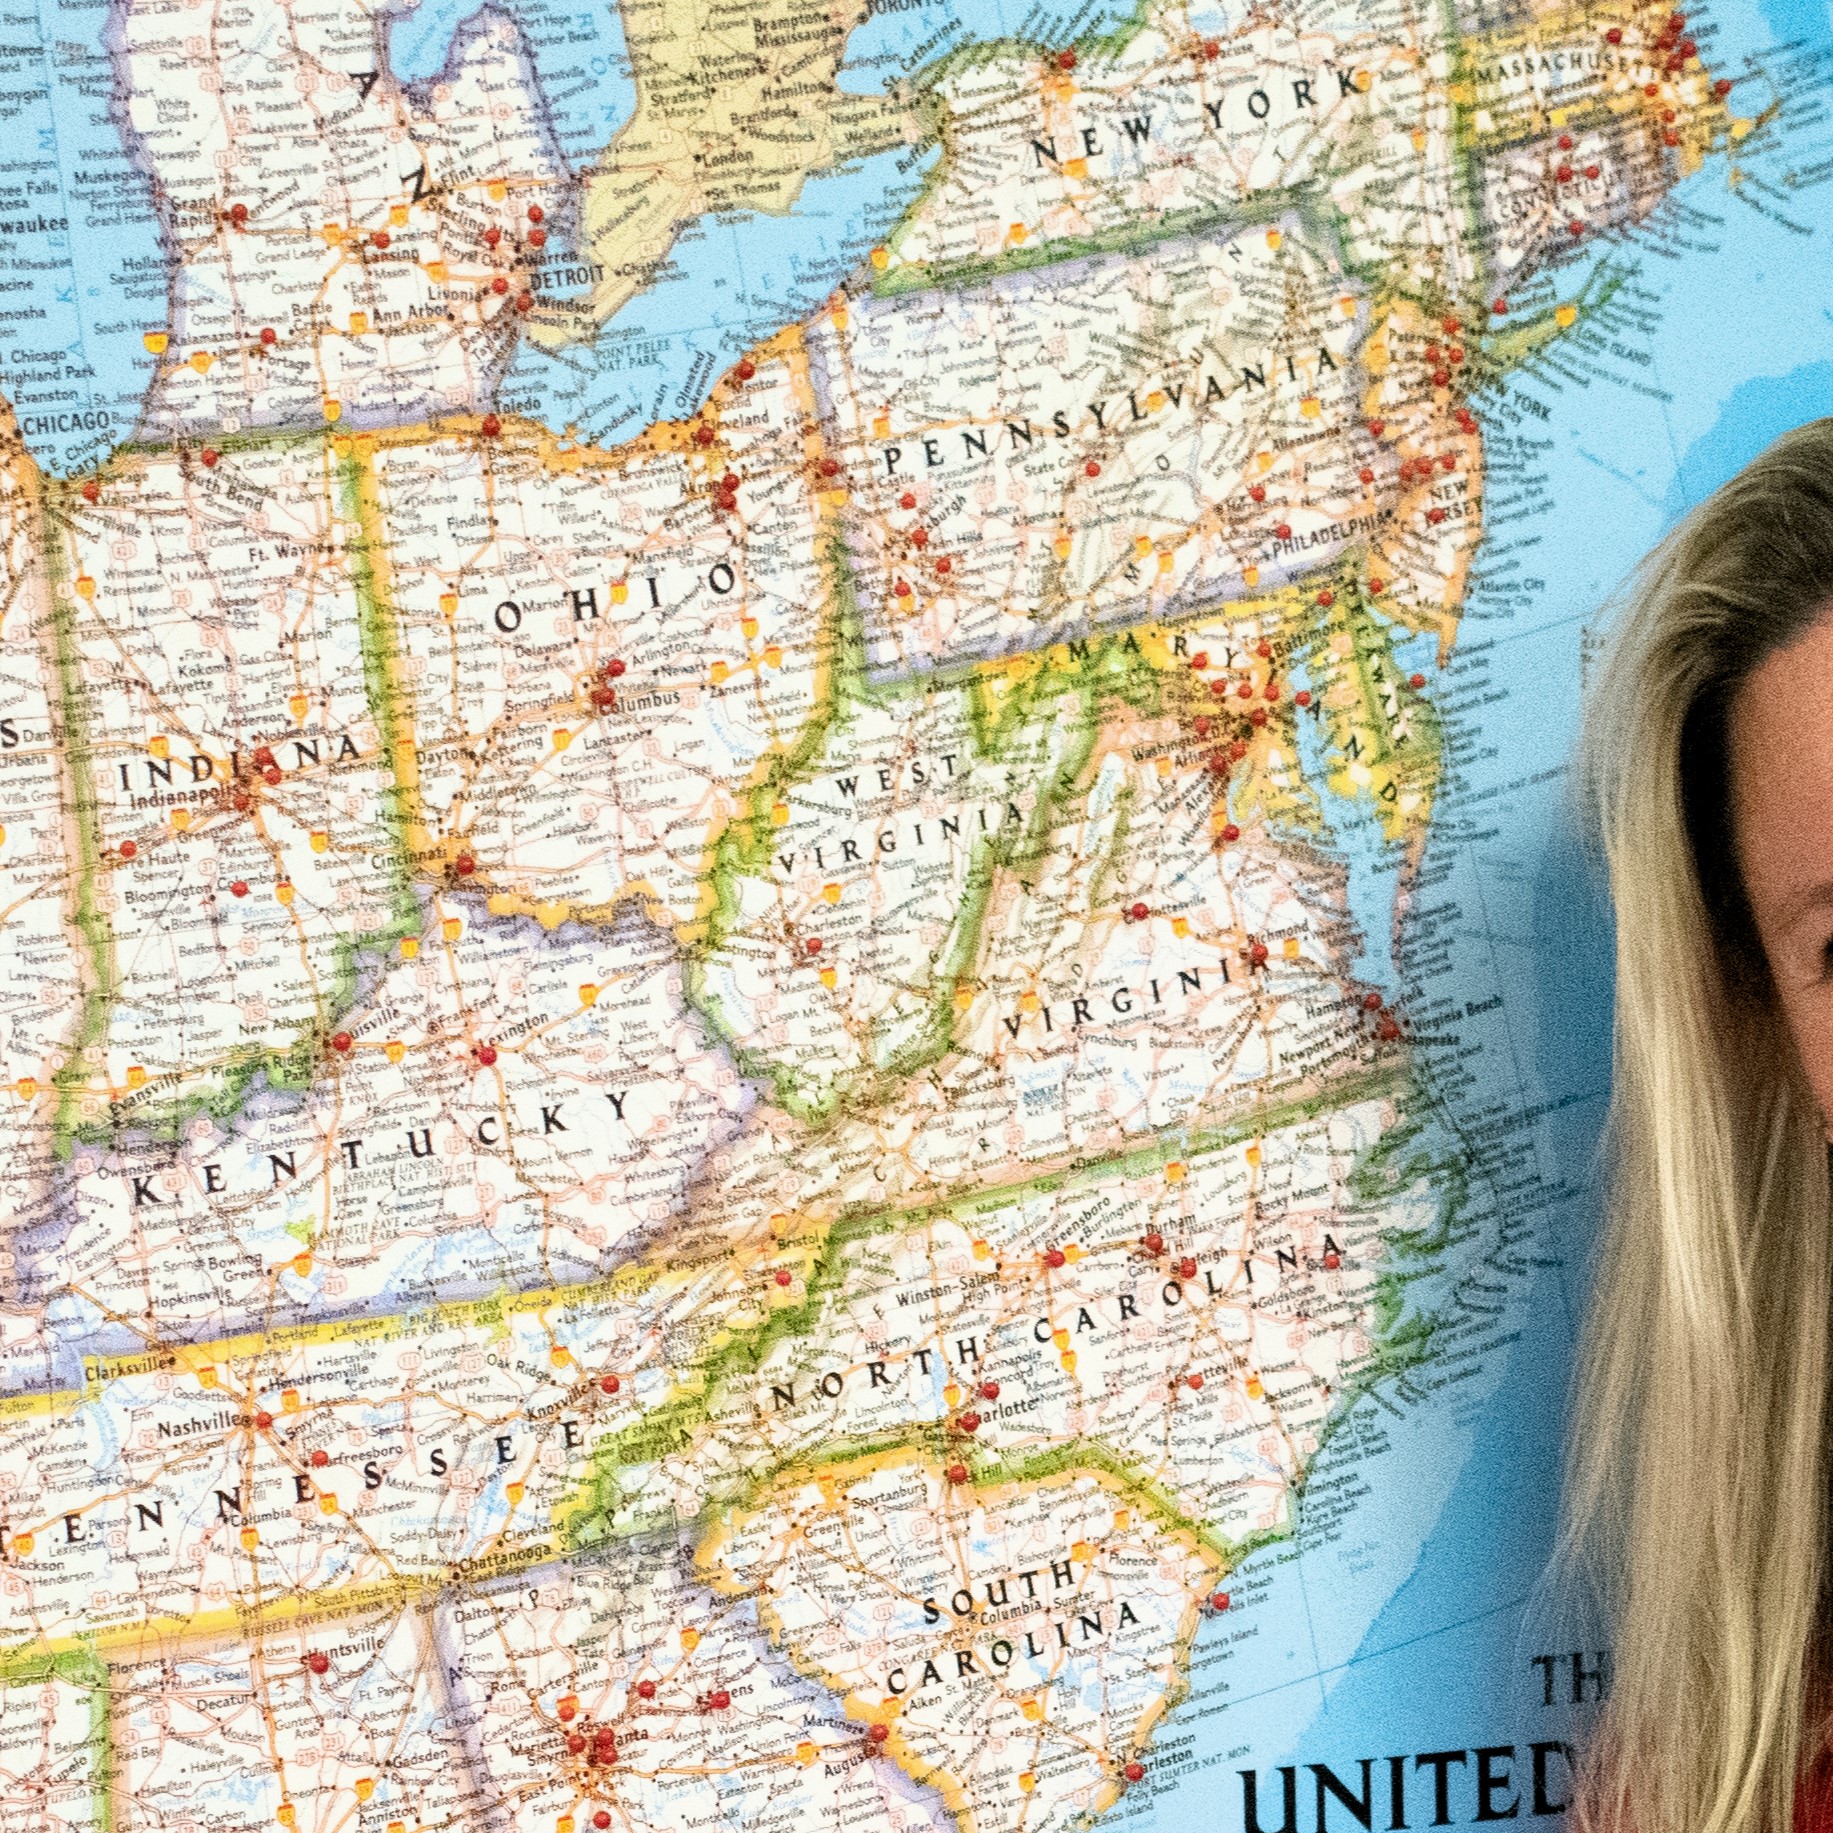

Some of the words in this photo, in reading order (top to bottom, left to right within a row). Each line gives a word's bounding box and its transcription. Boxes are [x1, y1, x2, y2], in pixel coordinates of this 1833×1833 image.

[1034, 116, 1152, 168] NEW
[1205, 67, 1373, 130] YORK
[530, 265, 604, 290] DETROIT
[23, 412, 109, 434] CHICAGO
[884, 347, 1337, 473] PENNSYLVANIA
[1272, 511, 1393, 558] PHILADELPHIA
[493, 563, 734, 632] OHIO
[605, 691, 680, 715] olumbus
[120, 734, 361, 792] INDINA
[837, 753, 958, 798] WEST
[779, 800, 1024, 876] VIRGINIA
[134, 1091, 629, 1205] KENTUCKY
[1035, 1234, 1340, 1345] CAROLINA
[772, 1337, 979, 1412] NORTH
[158, 1415, 241, 1438] Nashville
[312, 1445, 403, 1469] urfreesboro
[459, 1544, 551, 1571] Chattanooga
[924, 1563, 1074, 1624] SOUTH
[887, 1602, 1141, 1695] CAROLINA
[1532, 1654, 1614, 1706] TH
